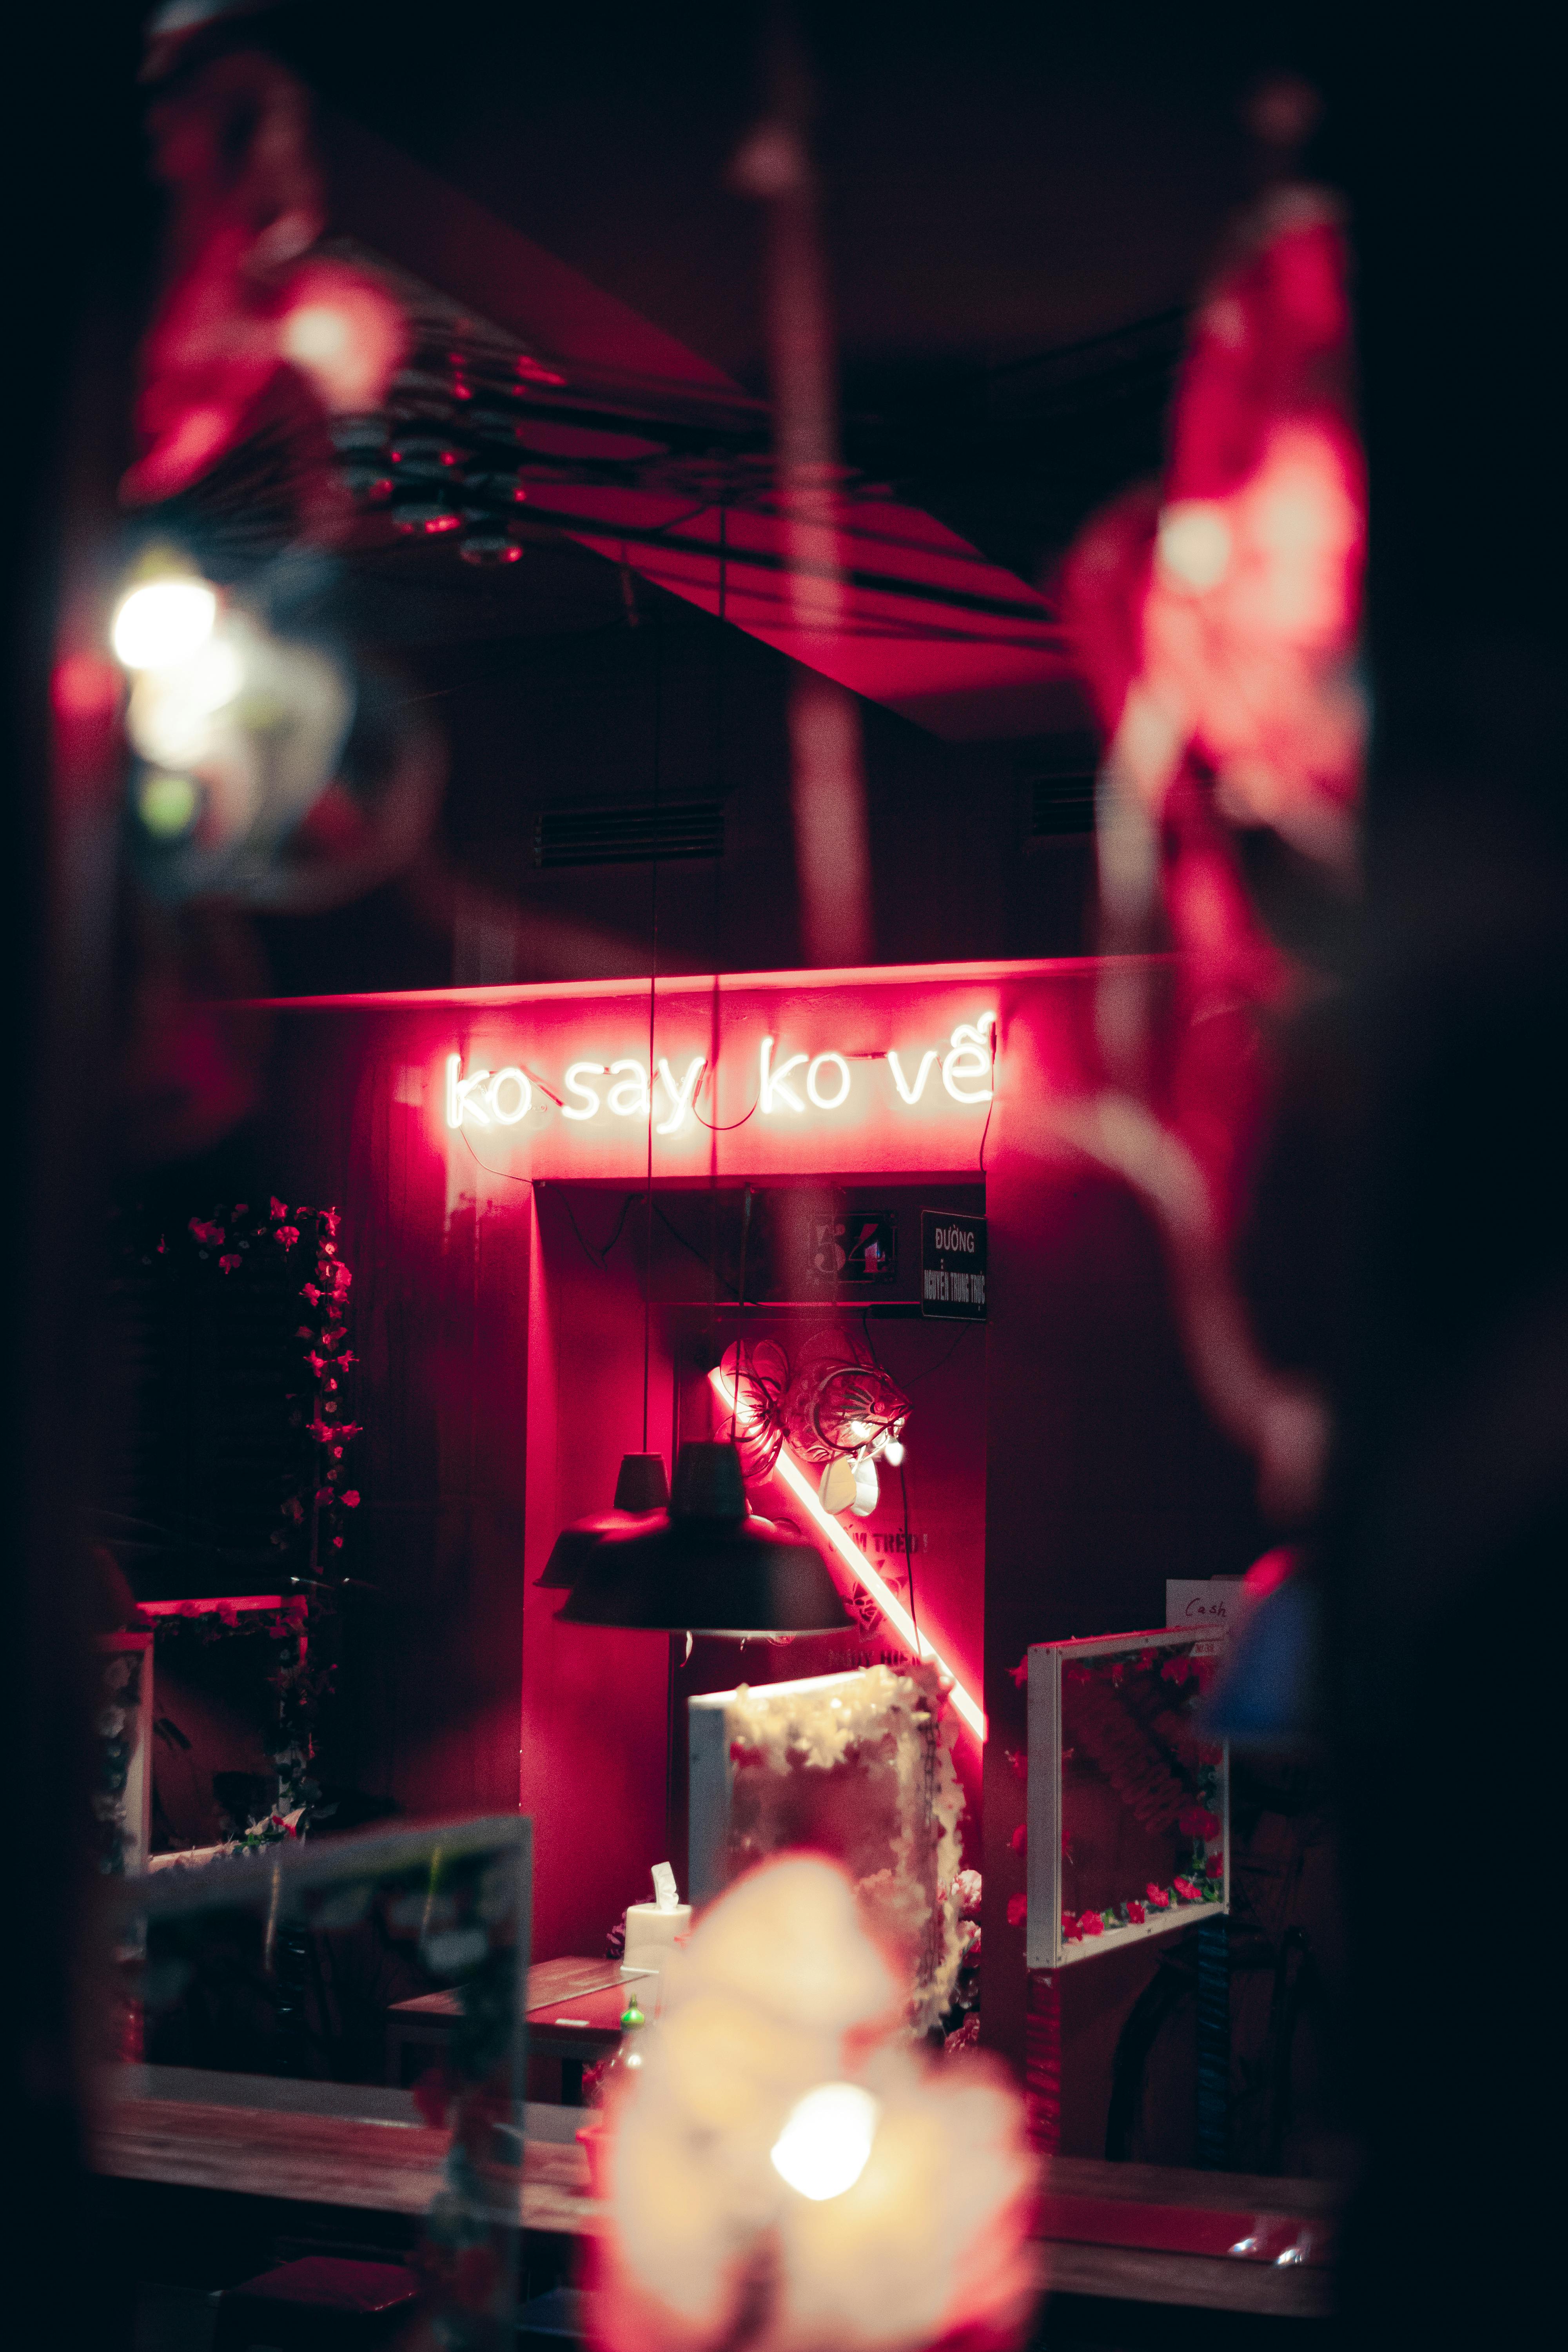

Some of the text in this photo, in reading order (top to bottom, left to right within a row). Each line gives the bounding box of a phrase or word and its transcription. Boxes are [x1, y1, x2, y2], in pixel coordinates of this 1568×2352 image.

[447, 1053, 532, 1128] ko
[562, 1056, 706, 1134] say
[760, 1036, 851, 1114] ko
[815, 1223, 886, 1274] 54
[935, 1224, 975, 1253] ĐƯỜNG
[1185, 1598, 1227, 1617] Cash
